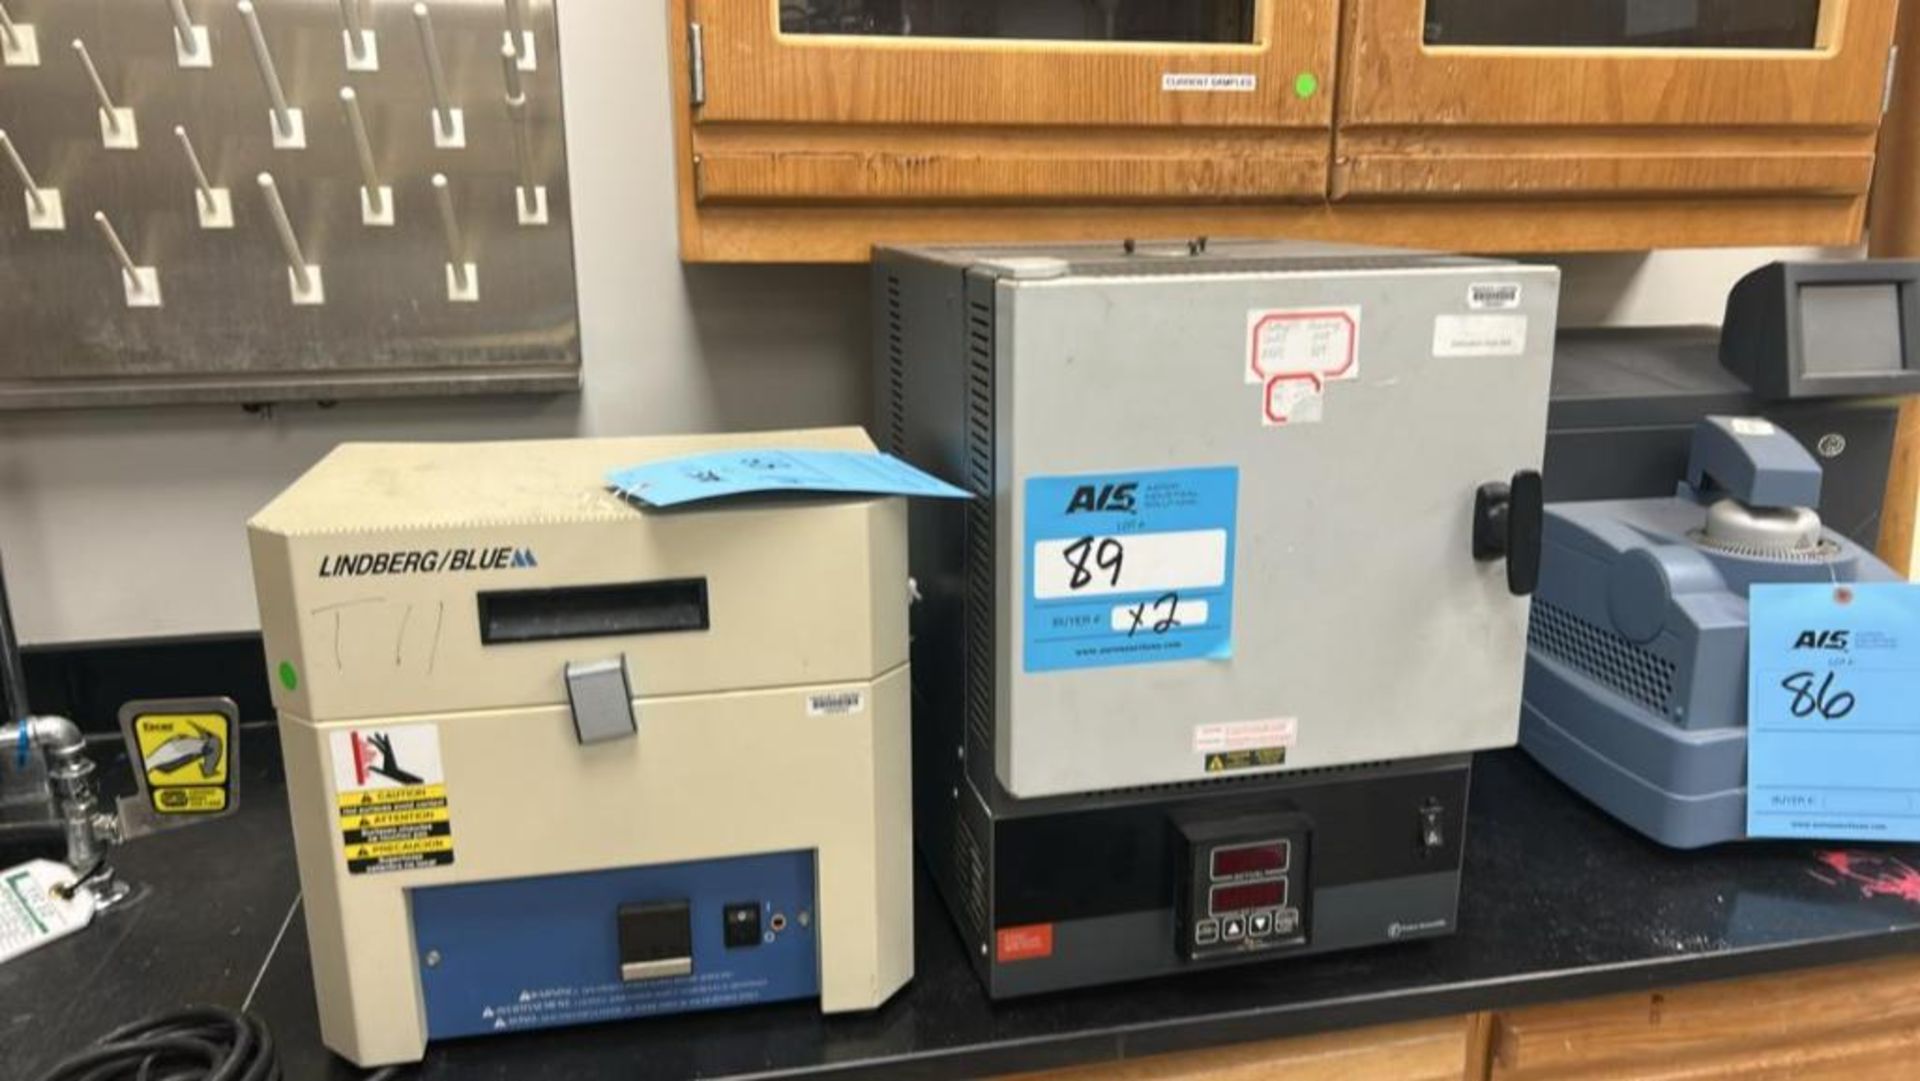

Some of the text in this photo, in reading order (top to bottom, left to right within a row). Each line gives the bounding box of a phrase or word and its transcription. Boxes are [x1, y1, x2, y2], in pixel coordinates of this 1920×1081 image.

[1211, 77, 1252, 87] SAMPLES
[1065, 482, 1139, 514] AIS
[1062, 535, 1124, 590] 89
[1053, 616, 1091, 628] BUYER
[1793, 630, 1850, 649] AIS
[1781, 671, 1855, 720] 86
[378, 788, 426, 800] CAUTION
[374, 811, 435, 824] ATTENTION
